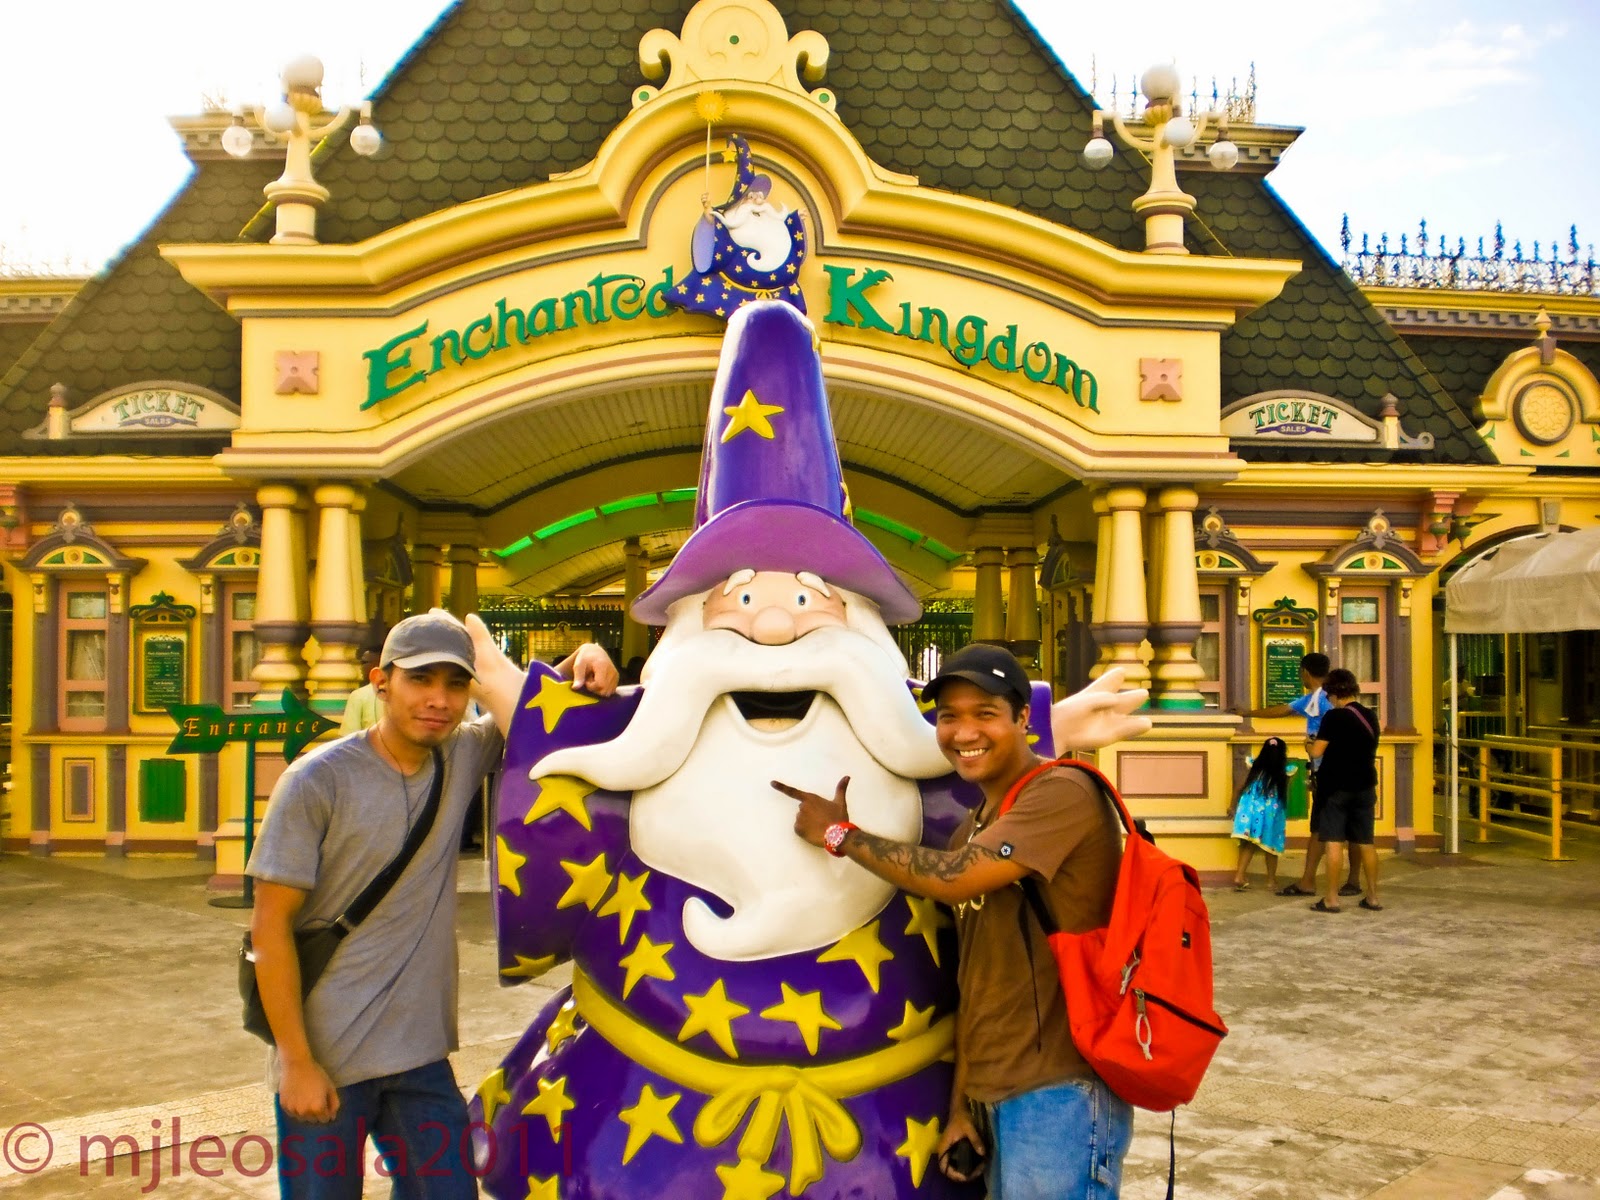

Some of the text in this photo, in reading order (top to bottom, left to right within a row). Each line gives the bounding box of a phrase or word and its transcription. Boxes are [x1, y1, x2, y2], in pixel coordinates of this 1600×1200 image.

[360, 264, 1100, 415] Enchanted Kingdom
[112, 391, 204, 420] TICKET
[1249, 401, 1338, 428] TICKET
[1280, 425, 1307, 433] SALES
[183, 717, 319, 737] Entrance
